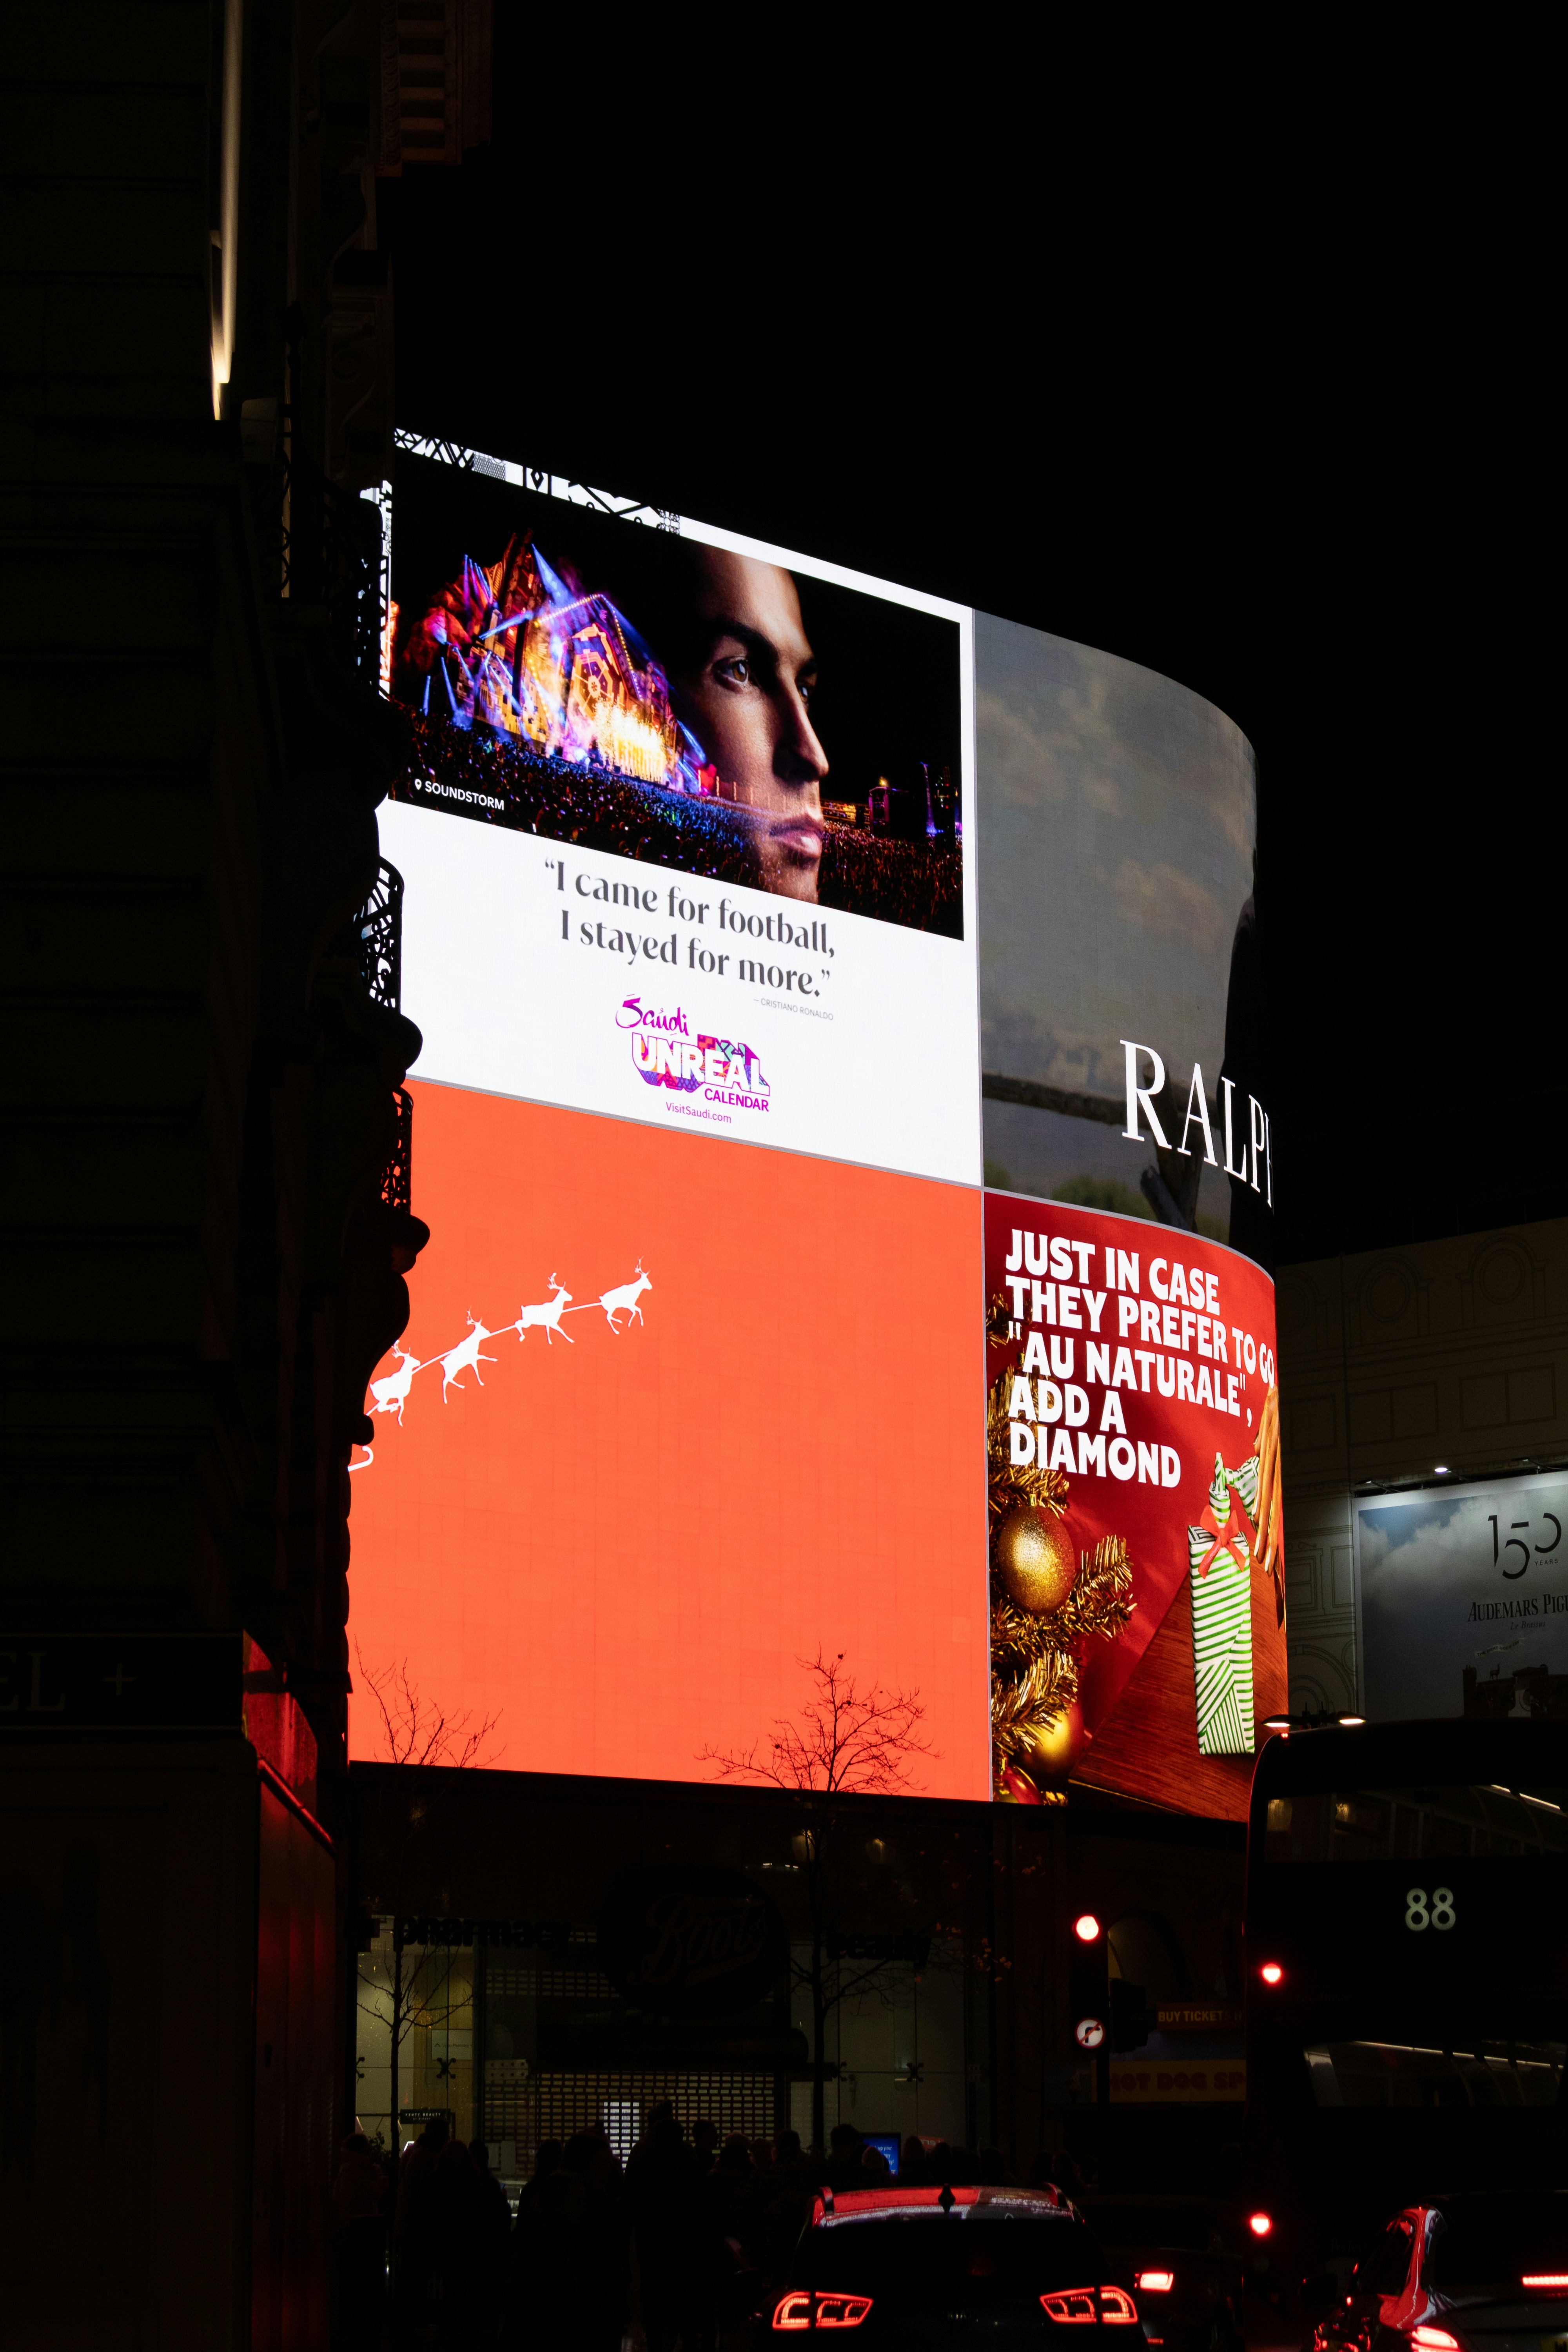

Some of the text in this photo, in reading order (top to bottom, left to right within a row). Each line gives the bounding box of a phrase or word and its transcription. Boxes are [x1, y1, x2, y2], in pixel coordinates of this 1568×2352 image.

[425, 781, 504, 810] SOUNDSTORM
[575, 873, 658, 913] came
[668, 886, 709, 924] for
[718, 898, 835, 958] football,
[561, 909, 830, 997] I stayed for more.”
[615, 994, 690, 1036] Saudi
[761, 998, 798, 1013] CRISTIANO
[800, 1006, 834, 1021] RONALDO
[632, 1032, 770, 1096] UNREAL
[666, 1102, 731, 1123] VisitSaudi.com
[704, 1088, 769, 1112] CALENDAR
[1005, 1229, 1220, 1316] JUST IN CASE
[1005, 1275, 1275, 1390] THEY PREFER TO GO
[1008, 1375, 1127, 1435] ADD A
[1009, 1421, 1181, 1489] DIAMOND
[1488, 1512, 1562, 1579] 150
[1534, 1558, 1559, 1566] YEARS
[1467, 1599, 1539, 1622] AUDEMARS
[1510, 1621, 1546, 1630] Le Brassus
[1405, 1887, 1457, 1932] 88
[394, 1915, 572, 1959] pharmacy
[1158, 2011, 1181, 2022] BUY
[1157, 2072, 1208, 2091] DOG
